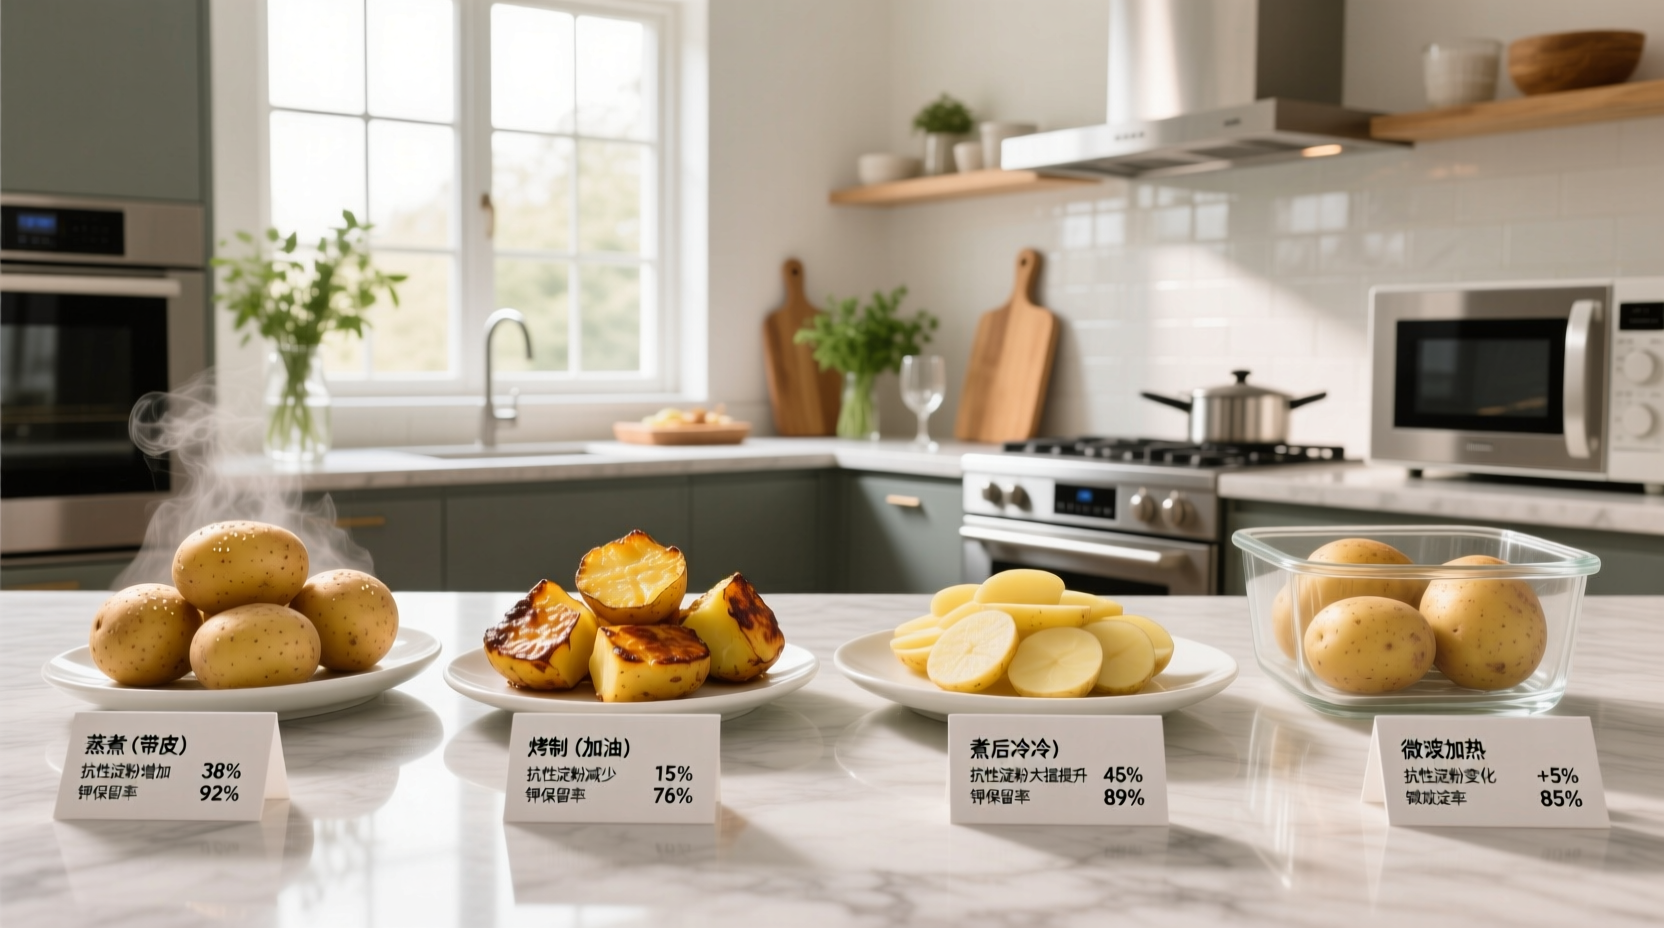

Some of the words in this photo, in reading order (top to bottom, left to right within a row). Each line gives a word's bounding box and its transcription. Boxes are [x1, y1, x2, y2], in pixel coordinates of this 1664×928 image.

[201, 762, 242, 780] 38%
[655, 764, 694, 783] 15%
[1102, 765, 1144, 784] 45%
[1537, 766, 1580, 785] +5%
[199, 784, 240, 802] 92%
[653, 786, 694, 805] 76%
[1103, 788, 1145, 807] 89%
[1539, 789, 1584, 808] 85%
